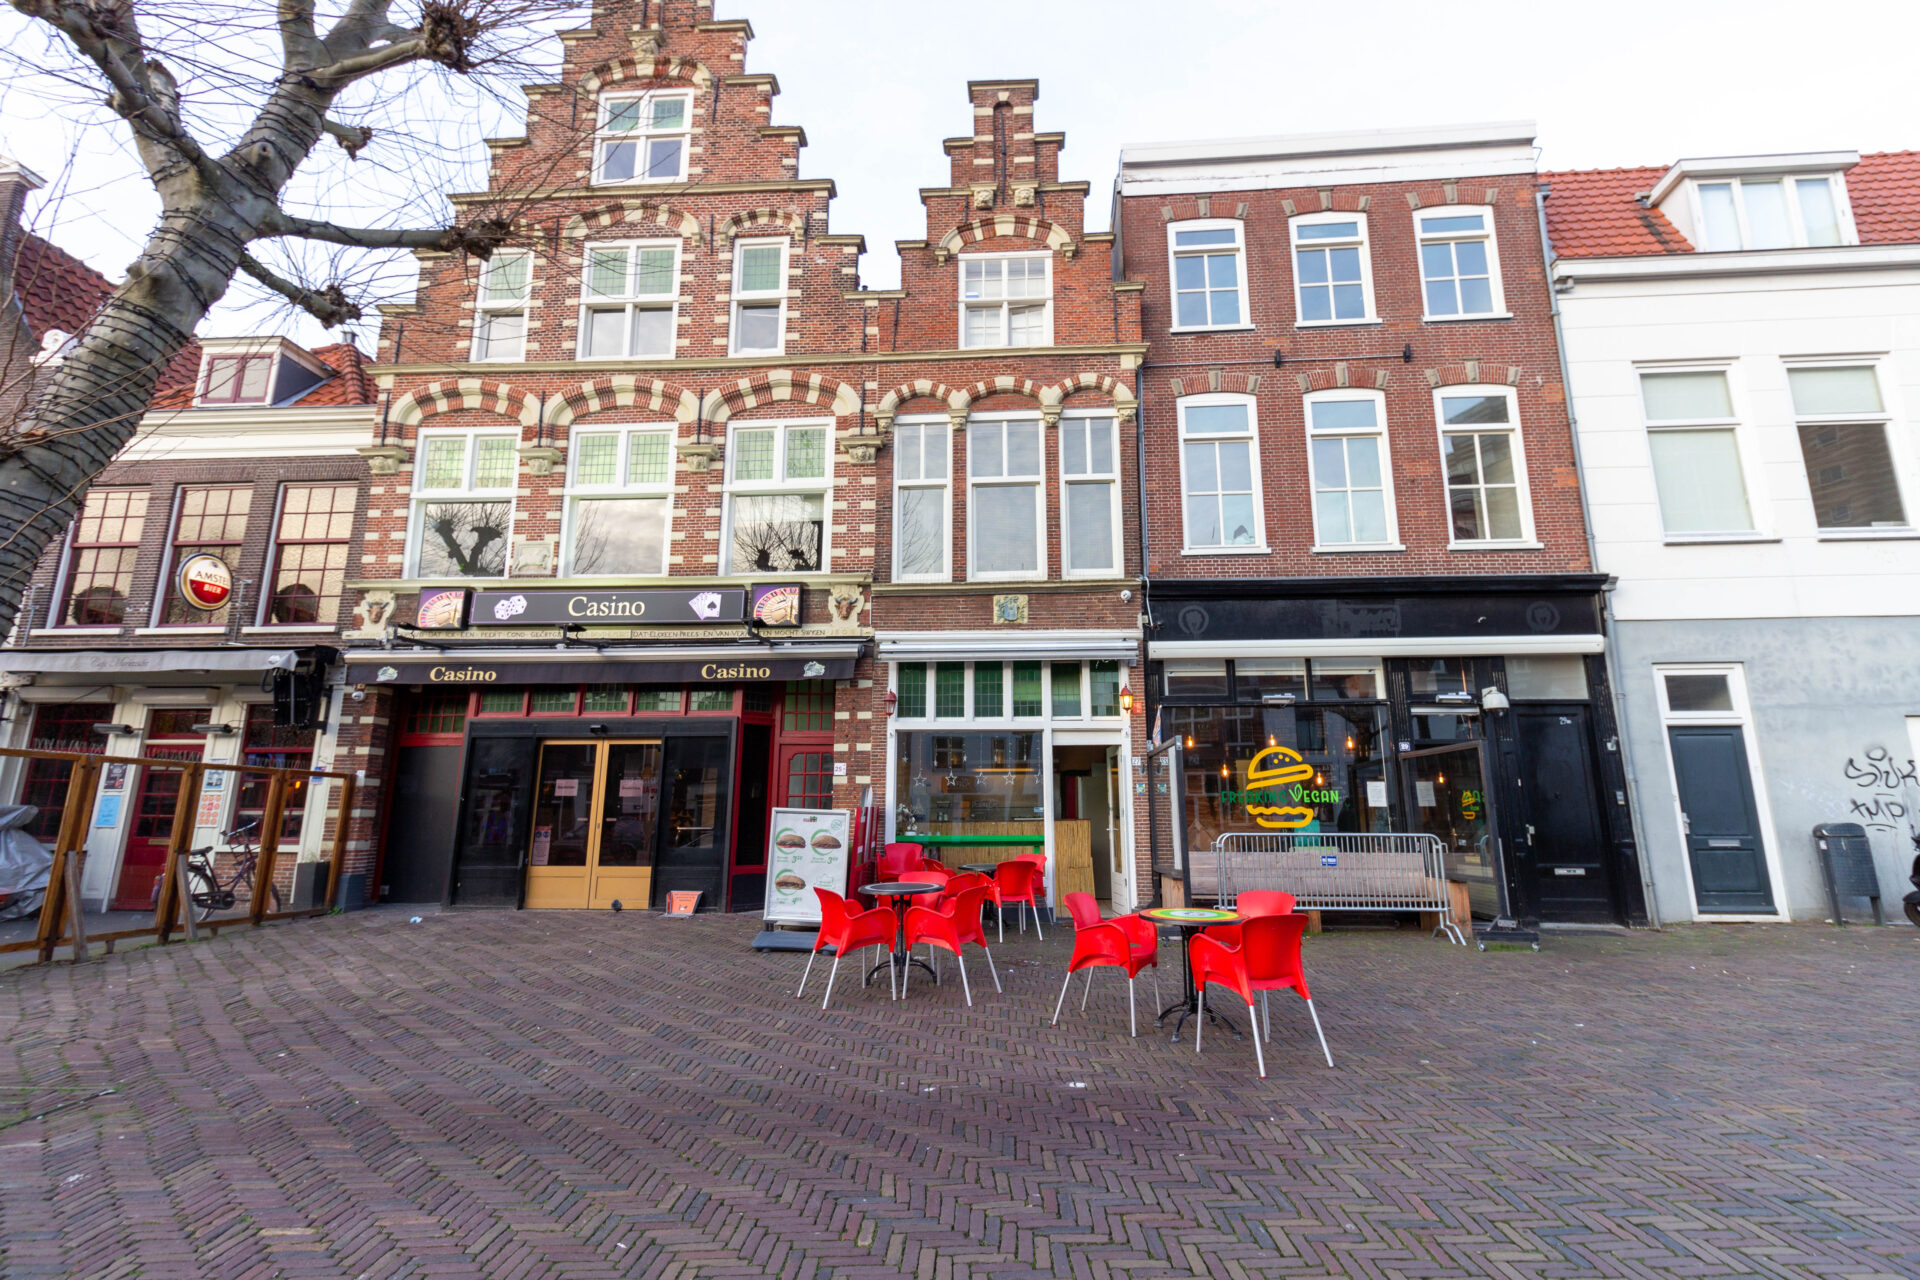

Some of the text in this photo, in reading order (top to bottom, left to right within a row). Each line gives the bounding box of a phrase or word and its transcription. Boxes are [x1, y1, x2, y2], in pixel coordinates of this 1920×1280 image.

[203, 583, 222, 594] BIER
[568, 595, 645, 617] Casino
[430, 666, 497, 682] Casino
[701, 664, 771, 679] Casino
[1221, 783, 1339, 803] FREAKING VEGAN
